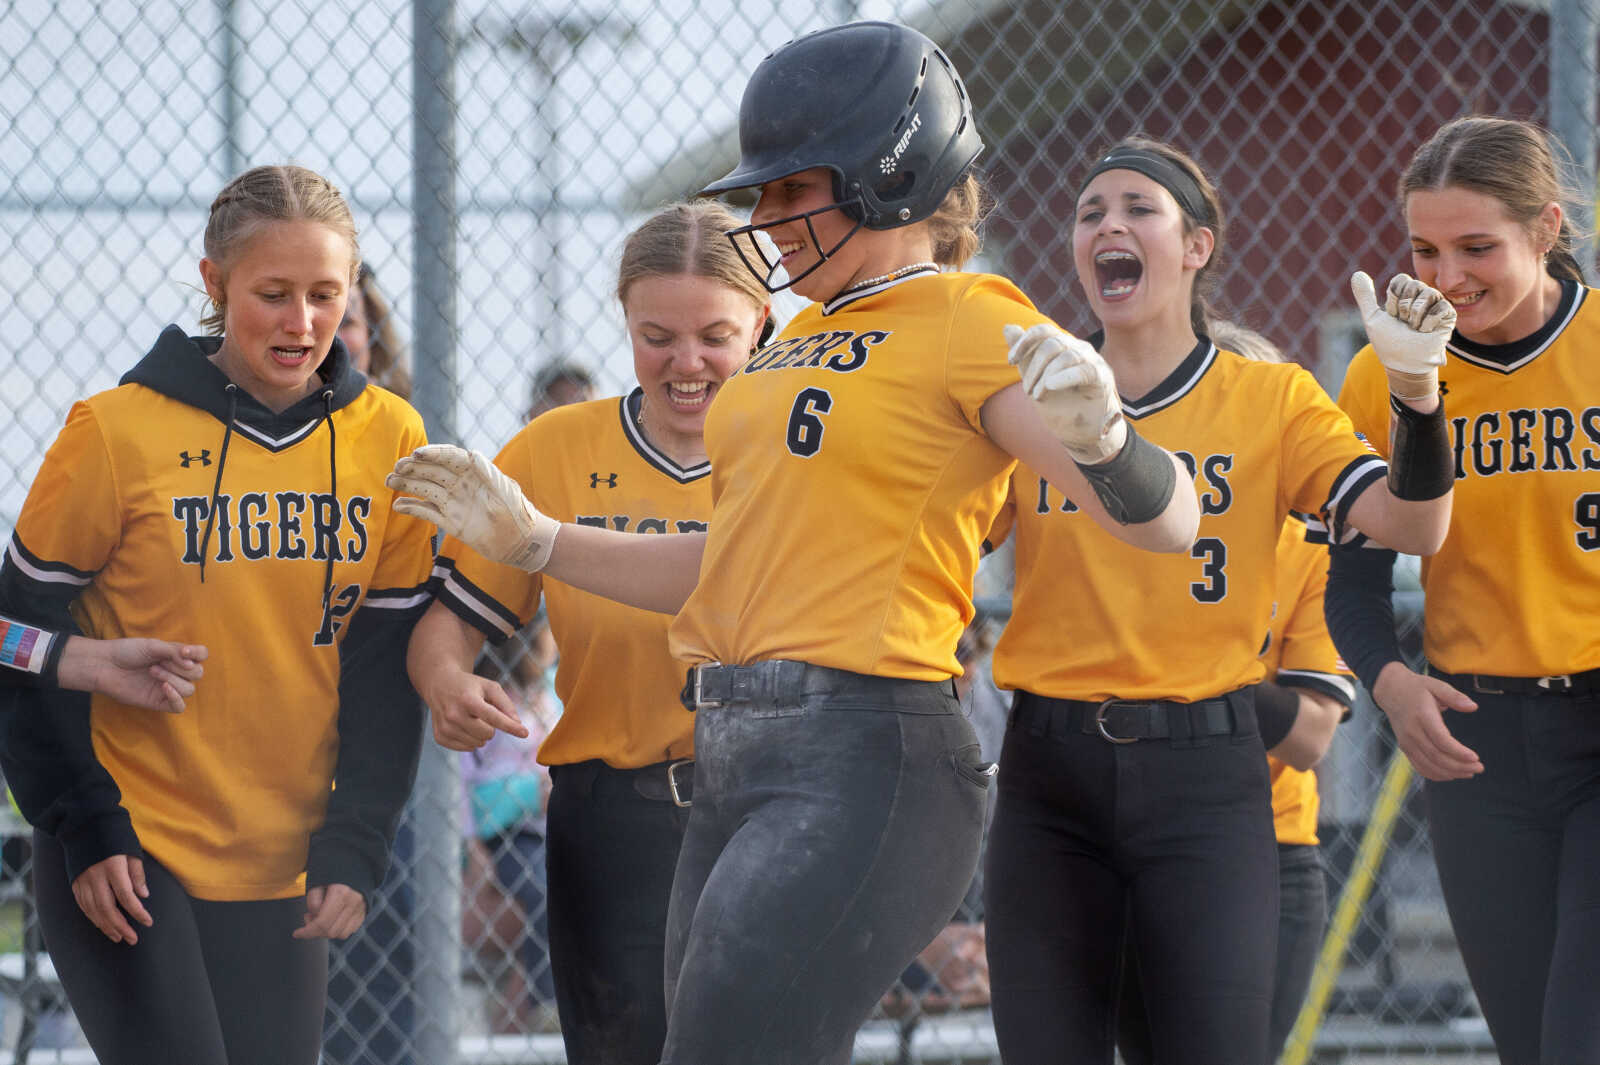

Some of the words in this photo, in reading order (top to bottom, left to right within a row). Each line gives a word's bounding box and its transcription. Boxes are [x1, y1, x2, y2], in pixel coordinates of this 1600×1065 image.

[730, 330, 893, 379] GERS
[786, 387, 833, 459] 6
[172, 490, 372, 564] TIGERS
[1573, 492, 1600, 552] 9
[1190, 537, 1228, 605] 3
[312, 584, 361, 647] 12
